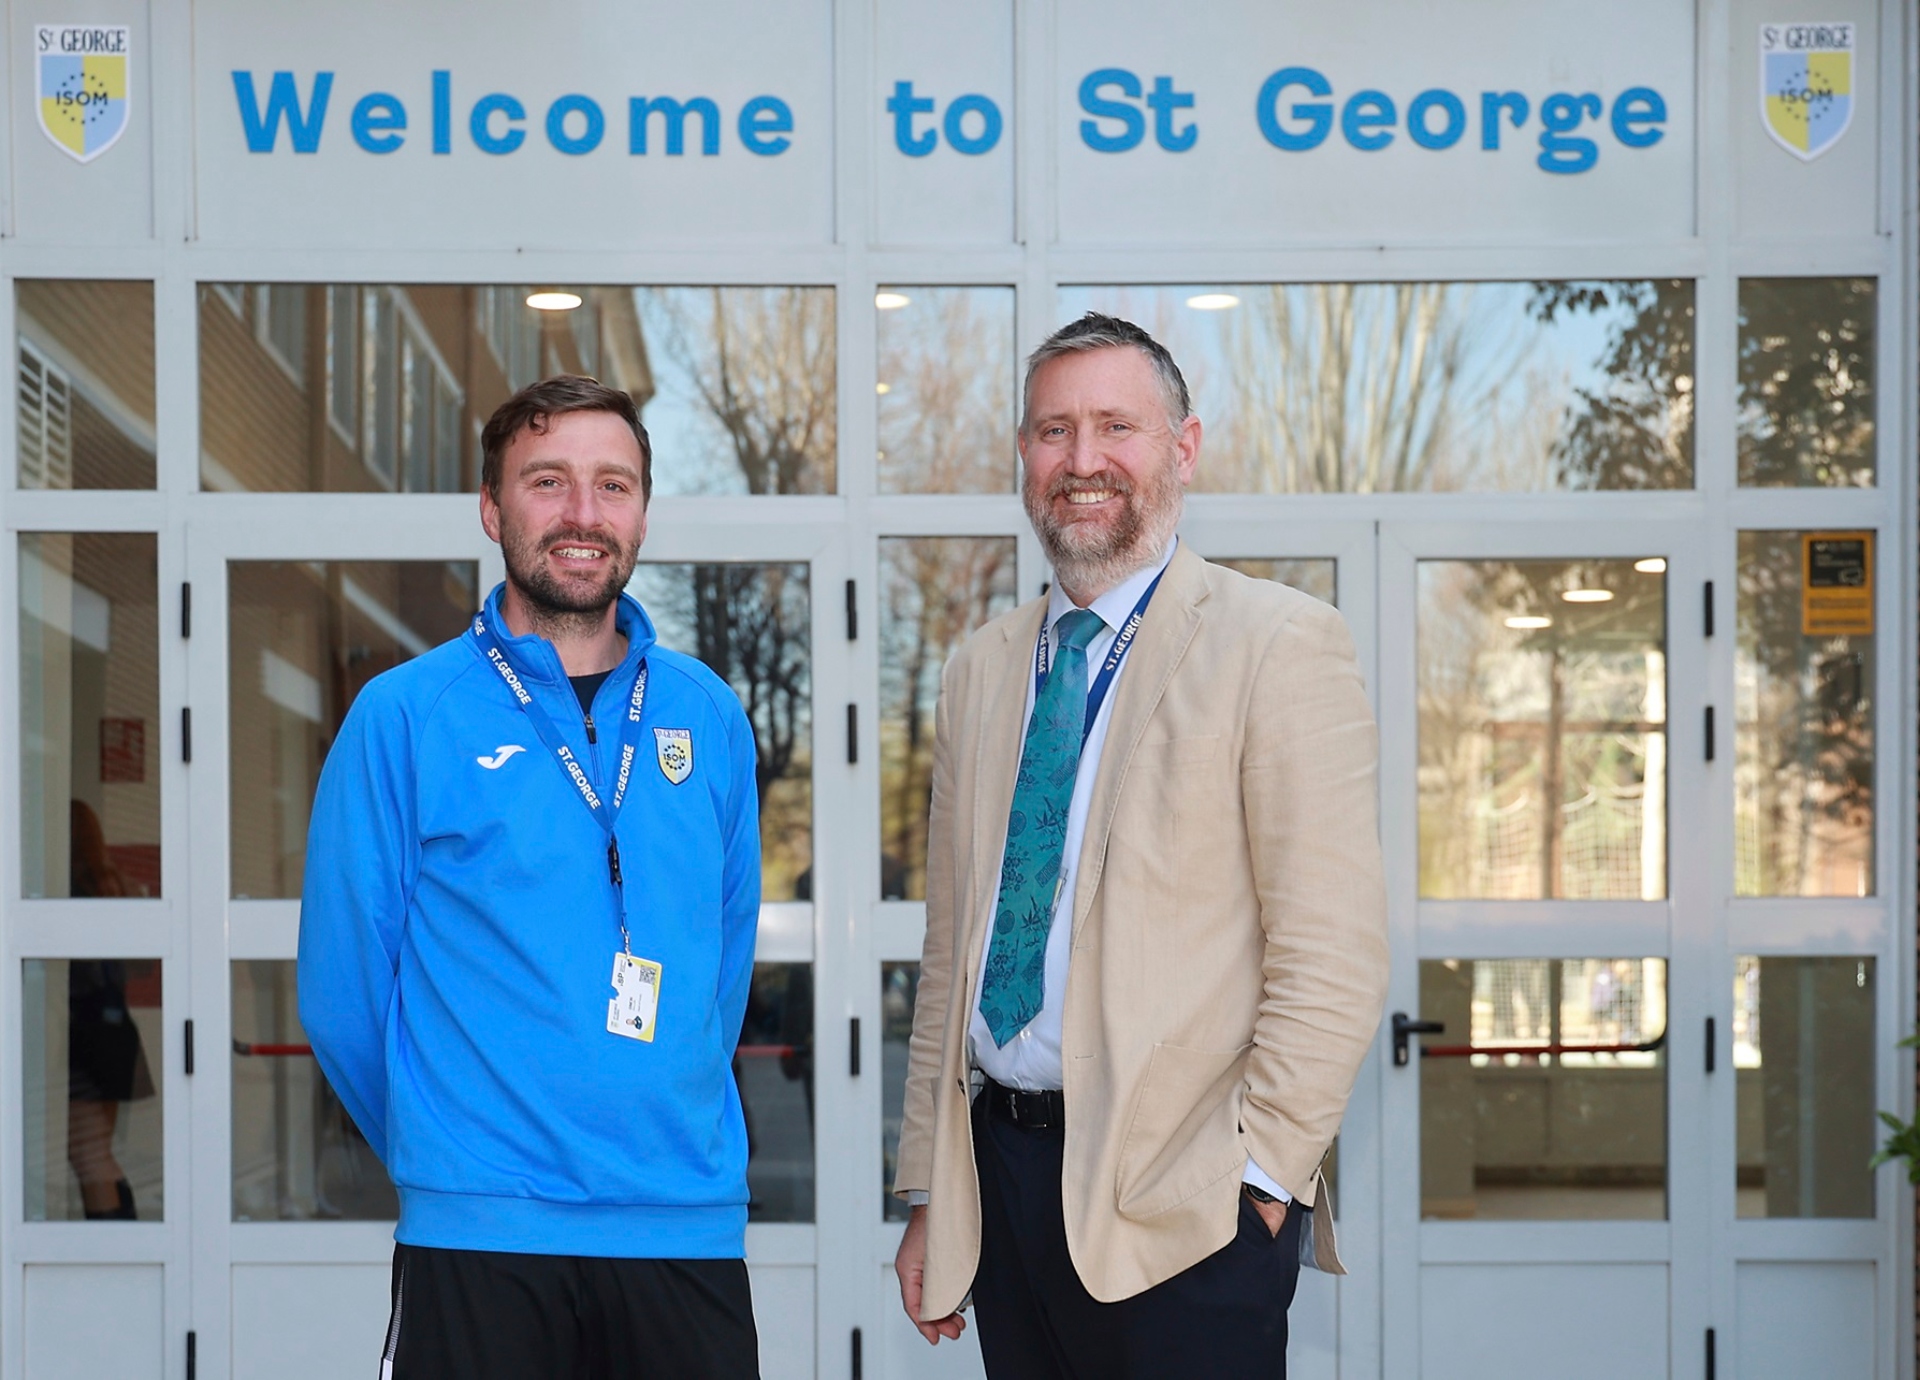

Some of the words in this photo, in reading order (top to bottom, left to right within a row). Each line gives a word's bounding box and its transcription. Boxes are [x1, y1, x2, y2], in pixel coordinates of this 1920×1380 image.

[60, 28, 126, 52] GEORGE
[1785, 25, 1851, 49] GEORGE
[56, 91, 108, 106] ISOM
[1780, 88, 1833, 104] ISOM
[231, 70, 795, 156] Welcome
[887, 80, 1004, 158] to
[1079, 67, 1199, 154] St
[1256, 66, 1668, 174] George
[1105, 611, 1143, 671] ST.GEORGE
[487, 648, 532, 705] ST.GEORGE
[557, 745, 601, 810] ST.GEORGE
[613, 744, 635, 808] ST.GEORGE
[663, 753, 687, 762] ISOM
